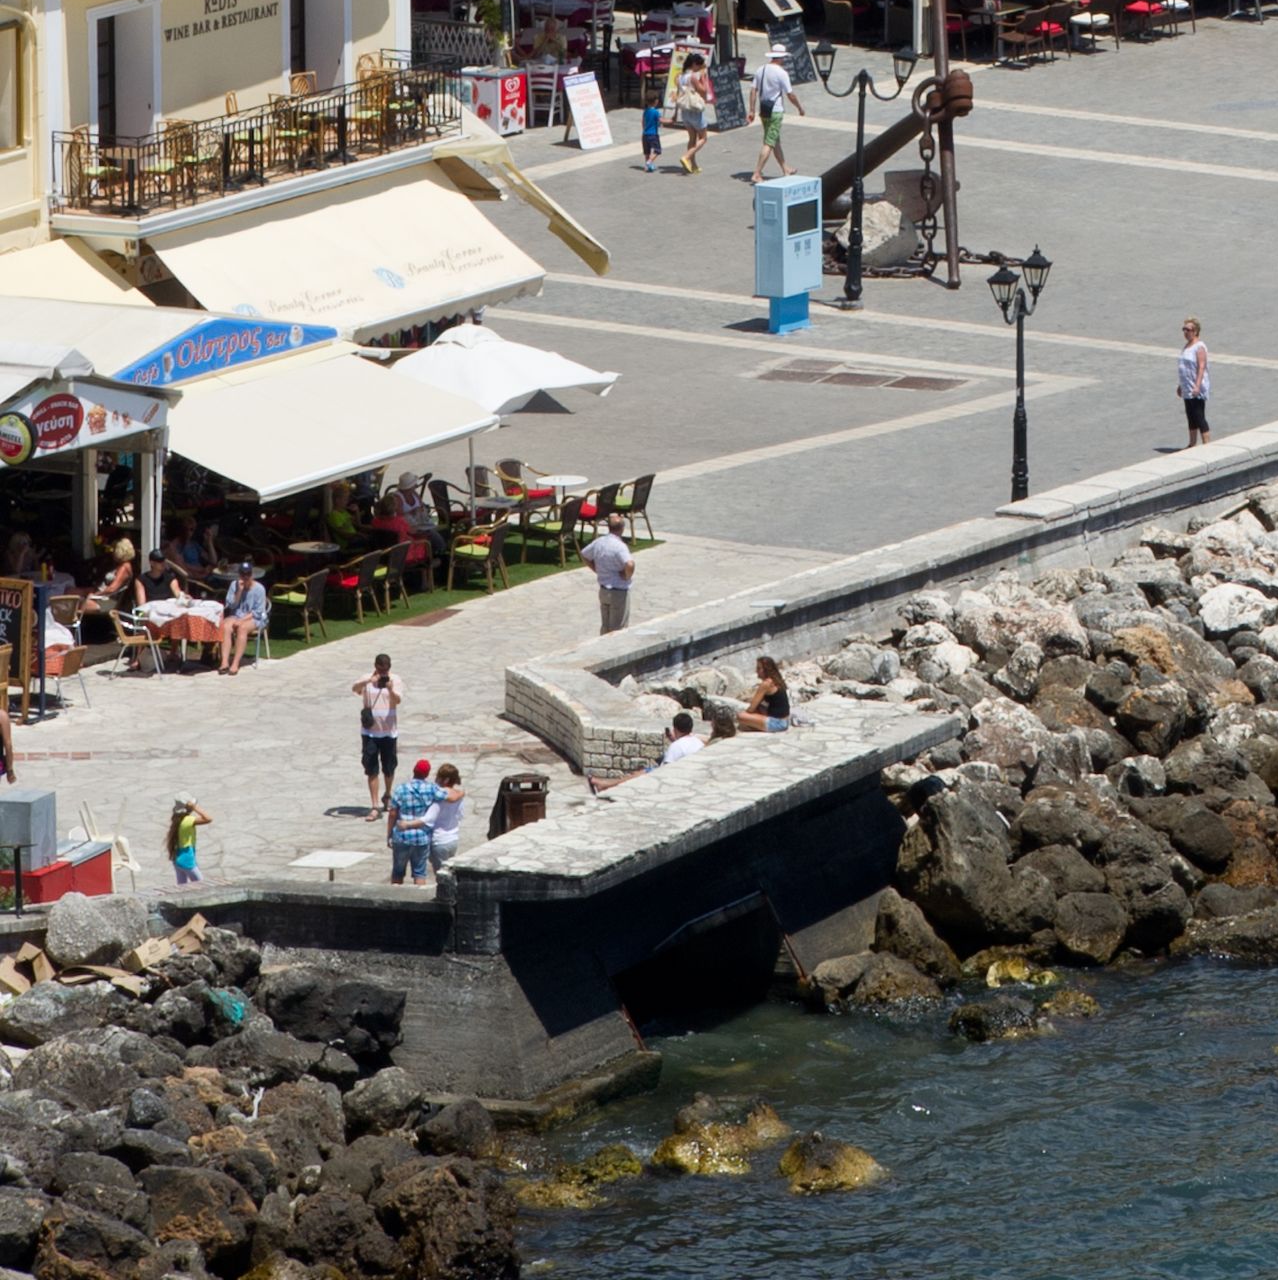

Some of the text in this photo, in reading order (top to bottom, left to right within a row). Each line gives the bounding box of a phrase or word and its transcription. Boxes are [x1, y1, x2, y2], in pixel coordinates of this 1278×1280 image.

[164, 2, 279, 42] WINE BAR & RESTAURANT
[176, 327, 263, 368] Οίστρος
[36, 413, 75, 437] γεύση
